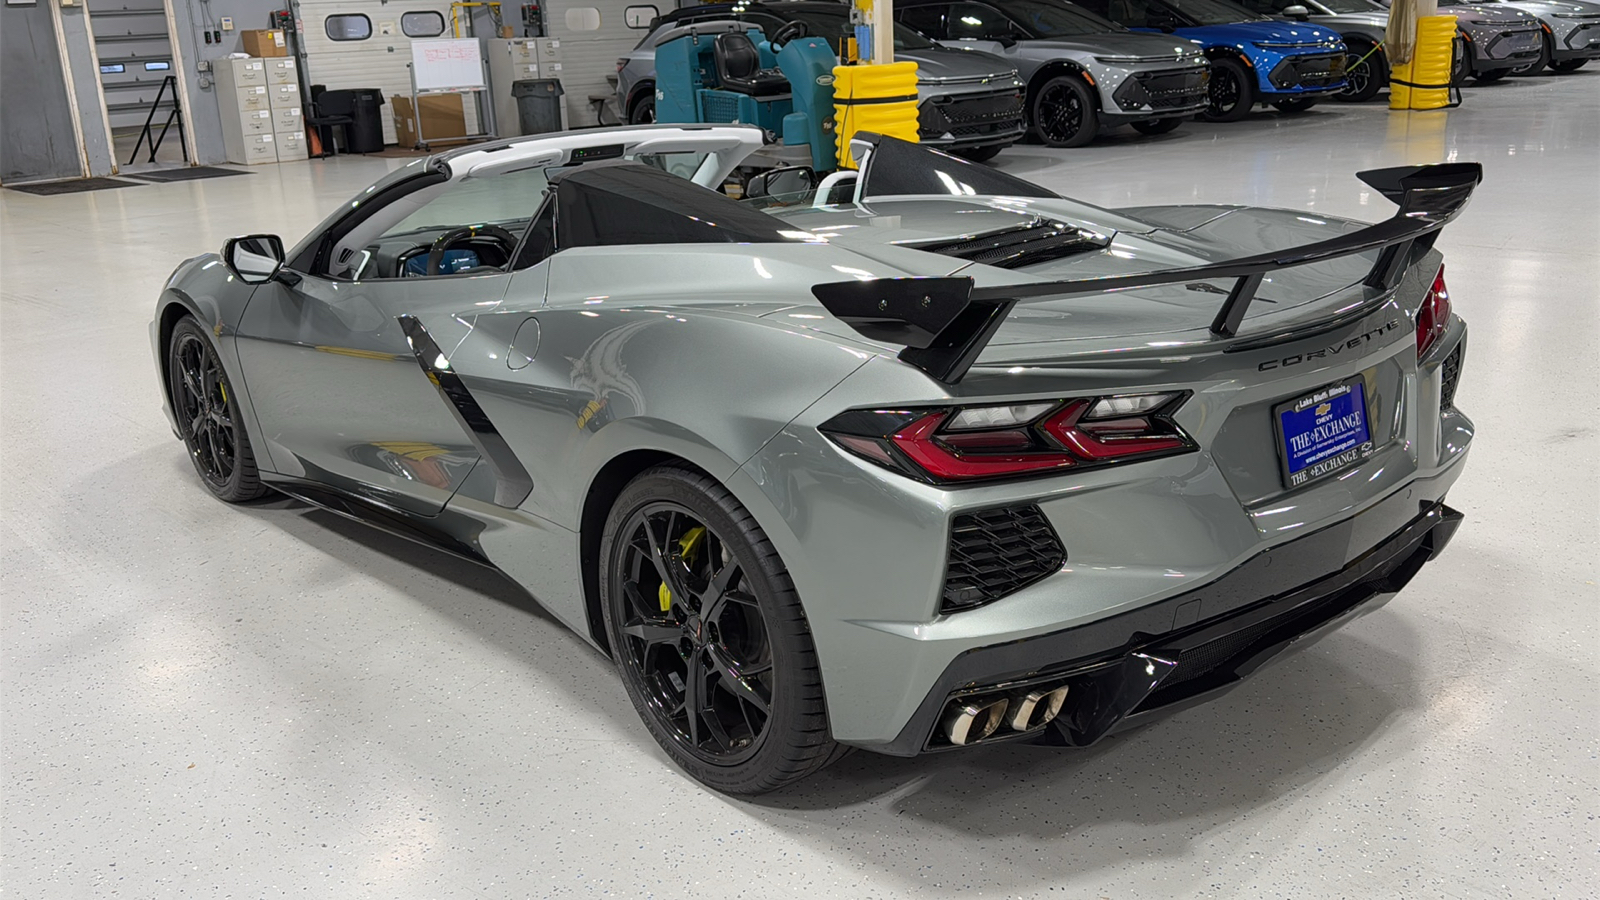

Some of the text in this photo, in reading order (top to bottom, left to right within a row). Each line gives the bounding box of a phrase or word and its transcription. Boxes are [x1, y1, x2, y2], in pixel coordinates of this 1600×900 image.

[1258, 318, 1399, 372] CORVETTE
[1299, 397, 1313, 408] Lake
[1329, 385, 1346, 397] Illinois
[1290, 411, 1362, 452] THE EXCHANGE
[1316, 413, 1333, 425] CHEVY
[1290, 448, 1359, 486] THE EXCHANGE
[1305, 438, 1356, 464] www.chevyexchange.com
